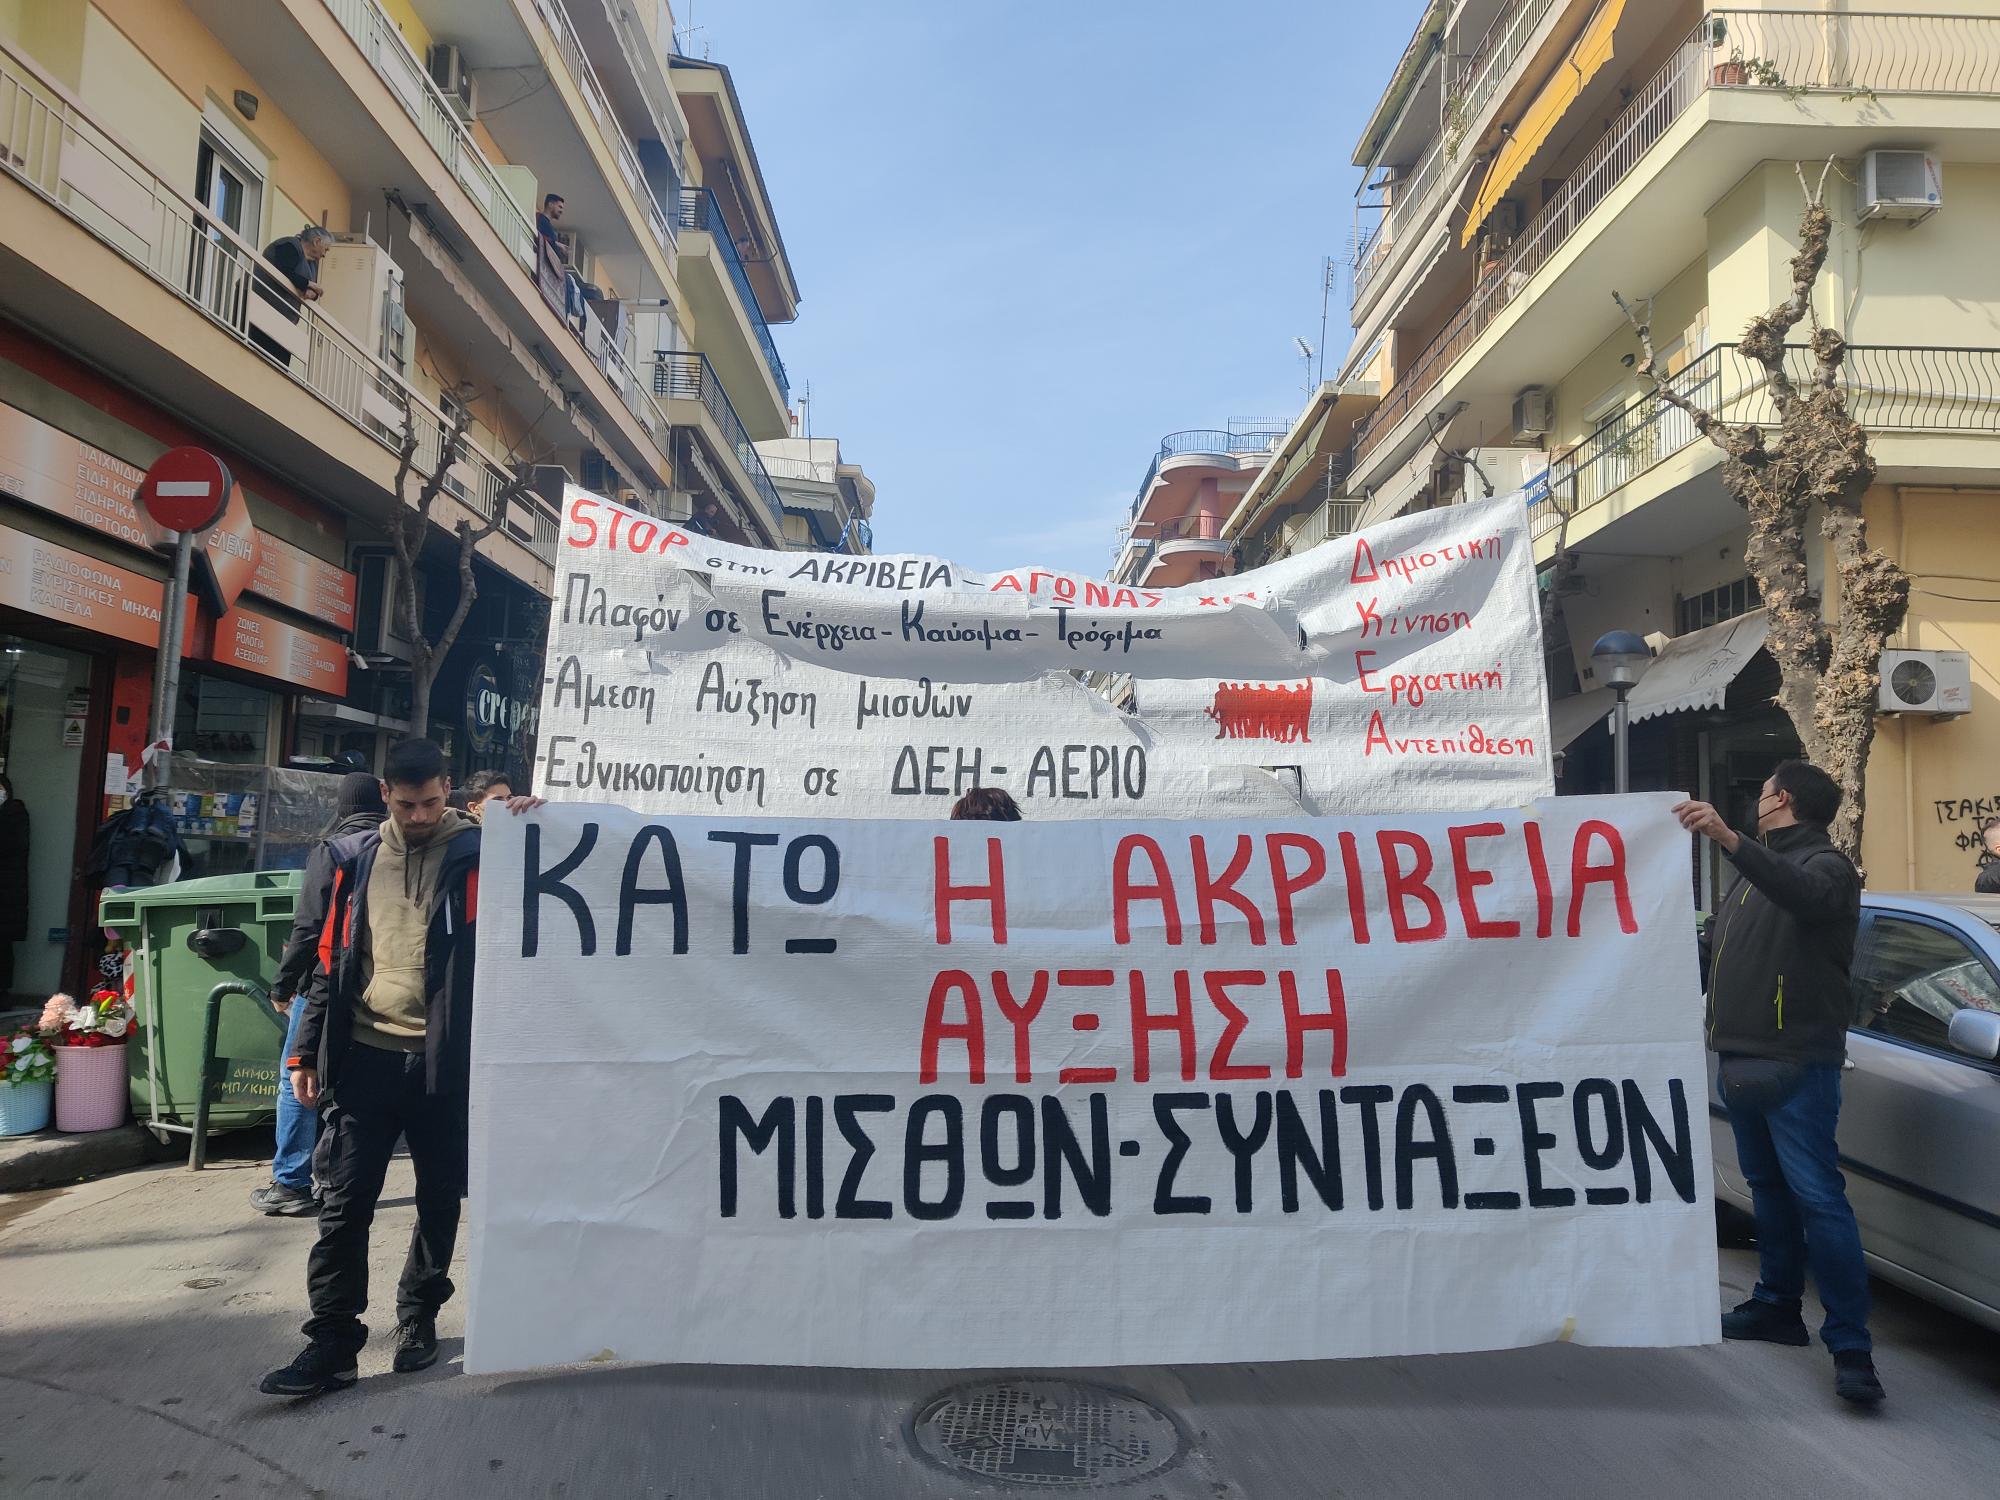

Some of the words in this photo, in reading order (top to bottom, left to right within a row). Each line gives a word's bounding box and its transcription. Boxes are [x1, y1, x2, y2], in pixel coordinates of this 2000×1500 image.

[77, 463, 109, 490] ΕΙΔΗ
[79, 442, 145, 484] ΠΑΙΧΝΙΔΙΑ
[74, 483, 137, 522] ΣΙΔΗΡΙΚΑ
[73, 504, 149, 547] ΠΟΡΤΟΦΟΛ
[32, 548, 122, 592] ΡΑΔΙΟΦΩΝΑ
[788, 557, 952, 591] ΑΚΡΙΒΕΙΑ
[1350, 528, 1502, 585] Δημοτική
[30, 586, 94, 619] ΚΑΠΕΛΑ
[31, 567, 116, 608] ΞΥΡΙΣΤΙΚΕΣ
[705, 609, 741, 634] σε
[1049, 605, 1163, 653] Τρόφιμα
[1356, 597, 1472, 639] Κίνηση
[696, 661, 817, 730] Αύξηση
[856, 677, 973, 730] μισθών
[1355, 650, 1503, 708] Εργατική
[1364, 709, 1535, 757] Αντεπίθεση
[803, 767, 840, 797] σε
[1027, 745, 1147, 800] ΑΕΡΙΟ
[521, 822, 840, 957] ΚΑΤΩ
[933, 835, 1008, 944] Η
[1112, 820, 1638, 945] ΑΚΡΙΒΕΙΑ
[919, 968, 1349, 1085] ΑΥΞΗΣΗ
[233, 1066, 277, 1081] ΔΗΜΟΣ
